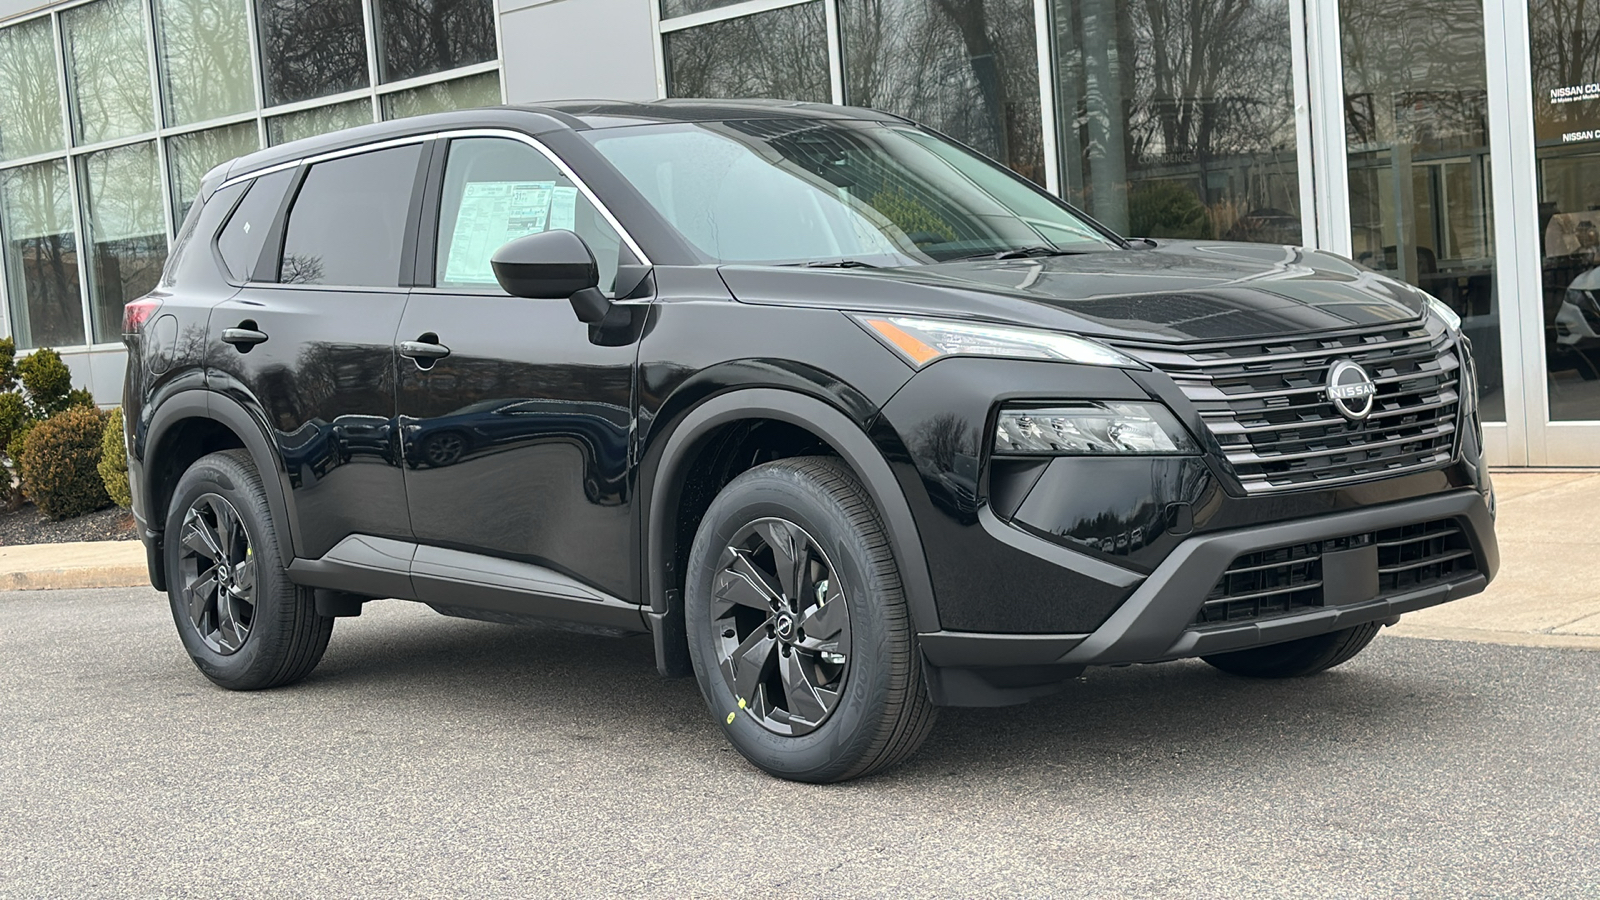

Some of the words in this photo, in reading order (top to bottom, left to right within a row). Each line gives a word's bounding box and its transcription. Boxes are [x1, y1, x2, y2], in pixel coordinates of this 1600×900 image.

[1551, 86, 1583, 97] NISSAN
[1562, 130, 1593, 142] NISSAN
[1138, 153, 1192, 164] CONFIDENCE
[1331, 384, 1376, 398] NISSAN
